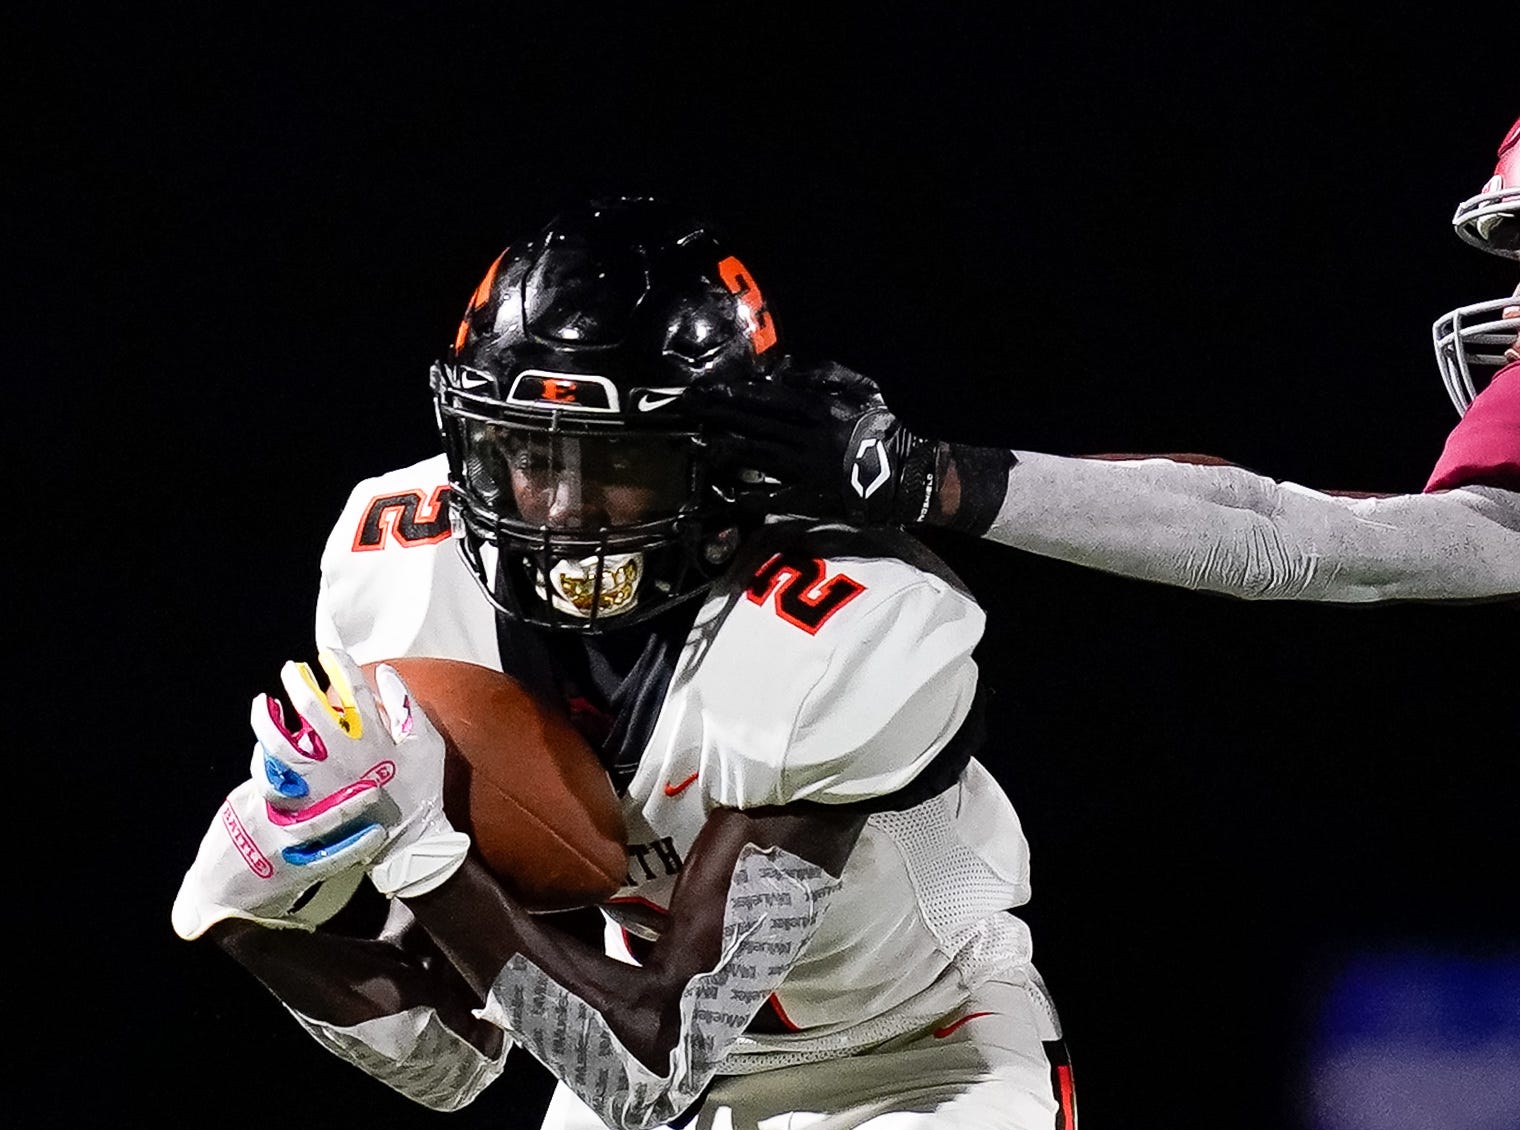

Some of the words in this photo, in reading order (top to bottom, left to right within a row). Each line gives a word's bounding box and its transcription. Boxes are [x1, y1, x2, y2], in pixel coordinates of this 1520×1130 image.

[718, 256, 777, 355] 2
[351, 484, 453, 552] 2
[745, 552, 869, 637] 2
[223, 806, 268, 874] BATTLE
[620, 836, 684, 887] TH
